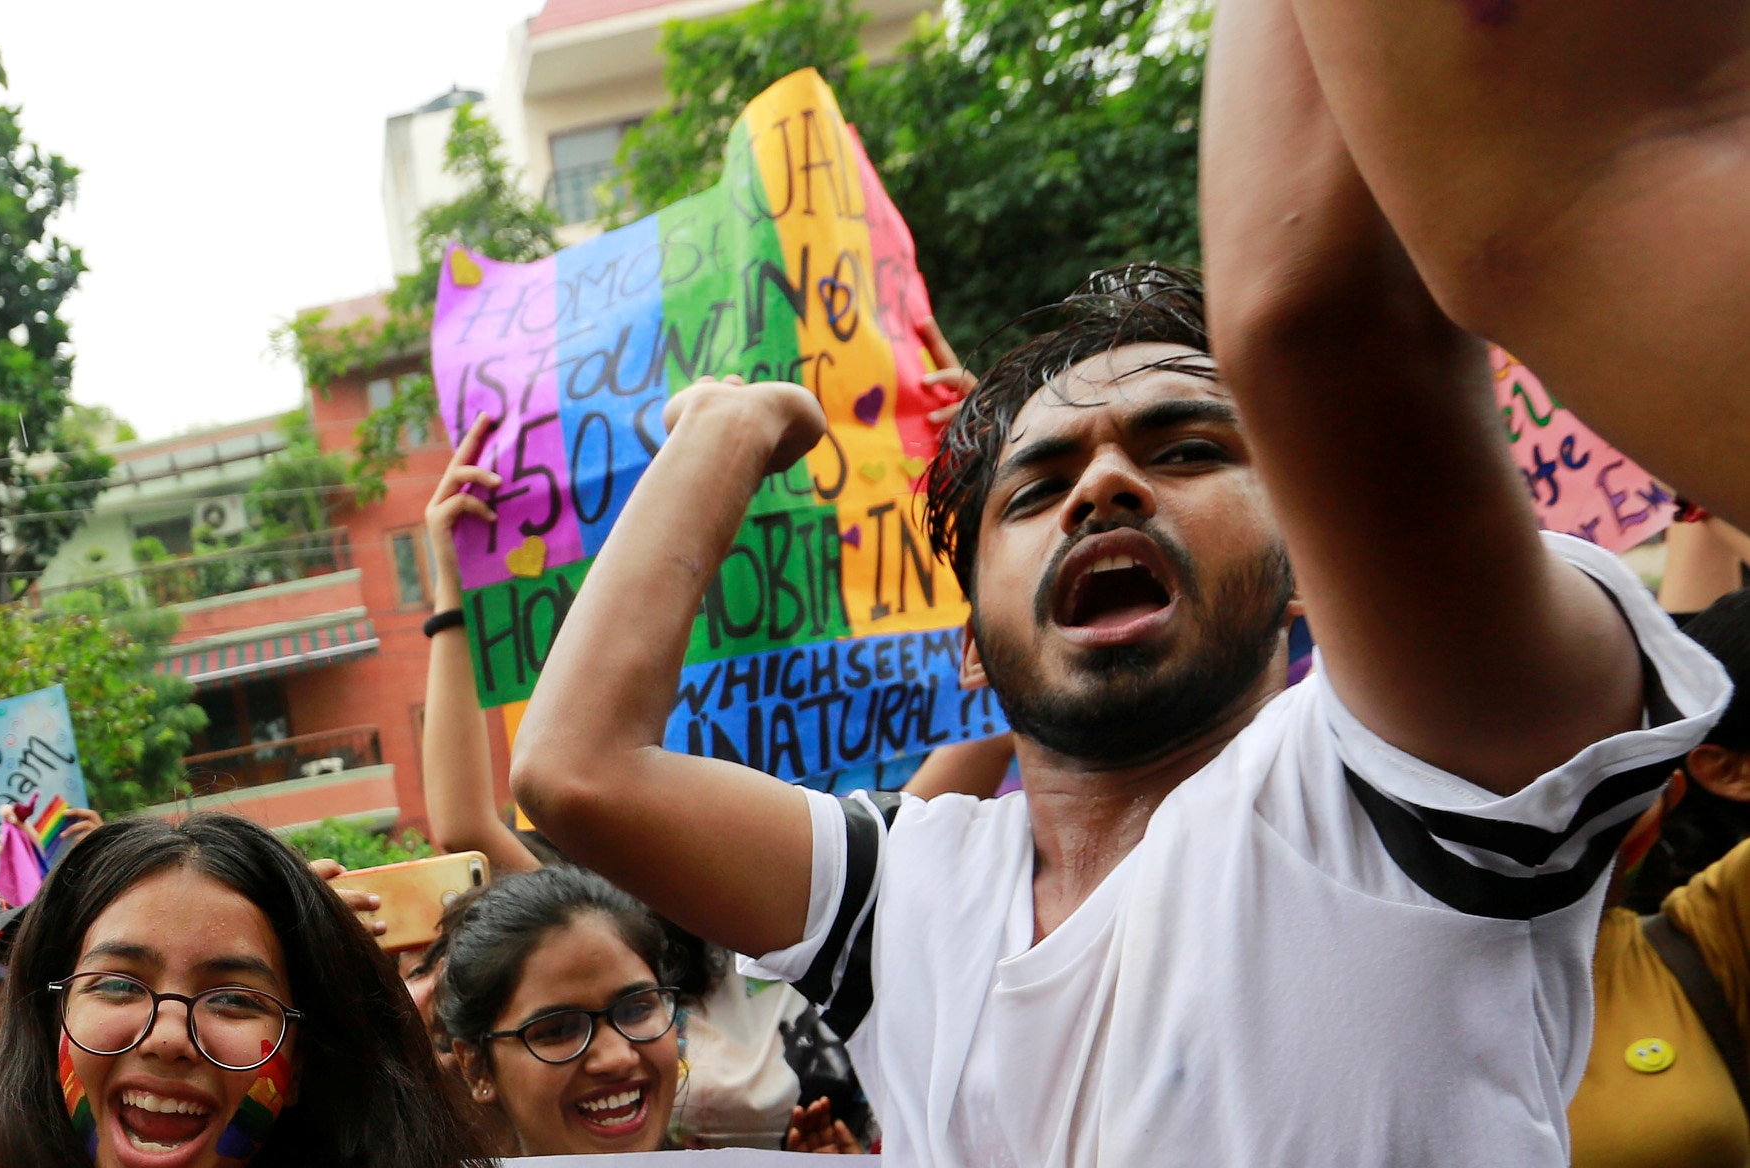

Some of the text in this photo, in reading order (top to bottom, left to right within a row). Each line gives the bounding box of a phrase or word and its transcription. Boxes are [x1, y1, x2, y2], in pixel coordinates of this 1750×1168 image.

[520, 298, 737, 415] FOUND
[740, 245, 810, 355] IN
[866, 502, 936, 621] IN
[670, 644, 838, 714] WHICH
